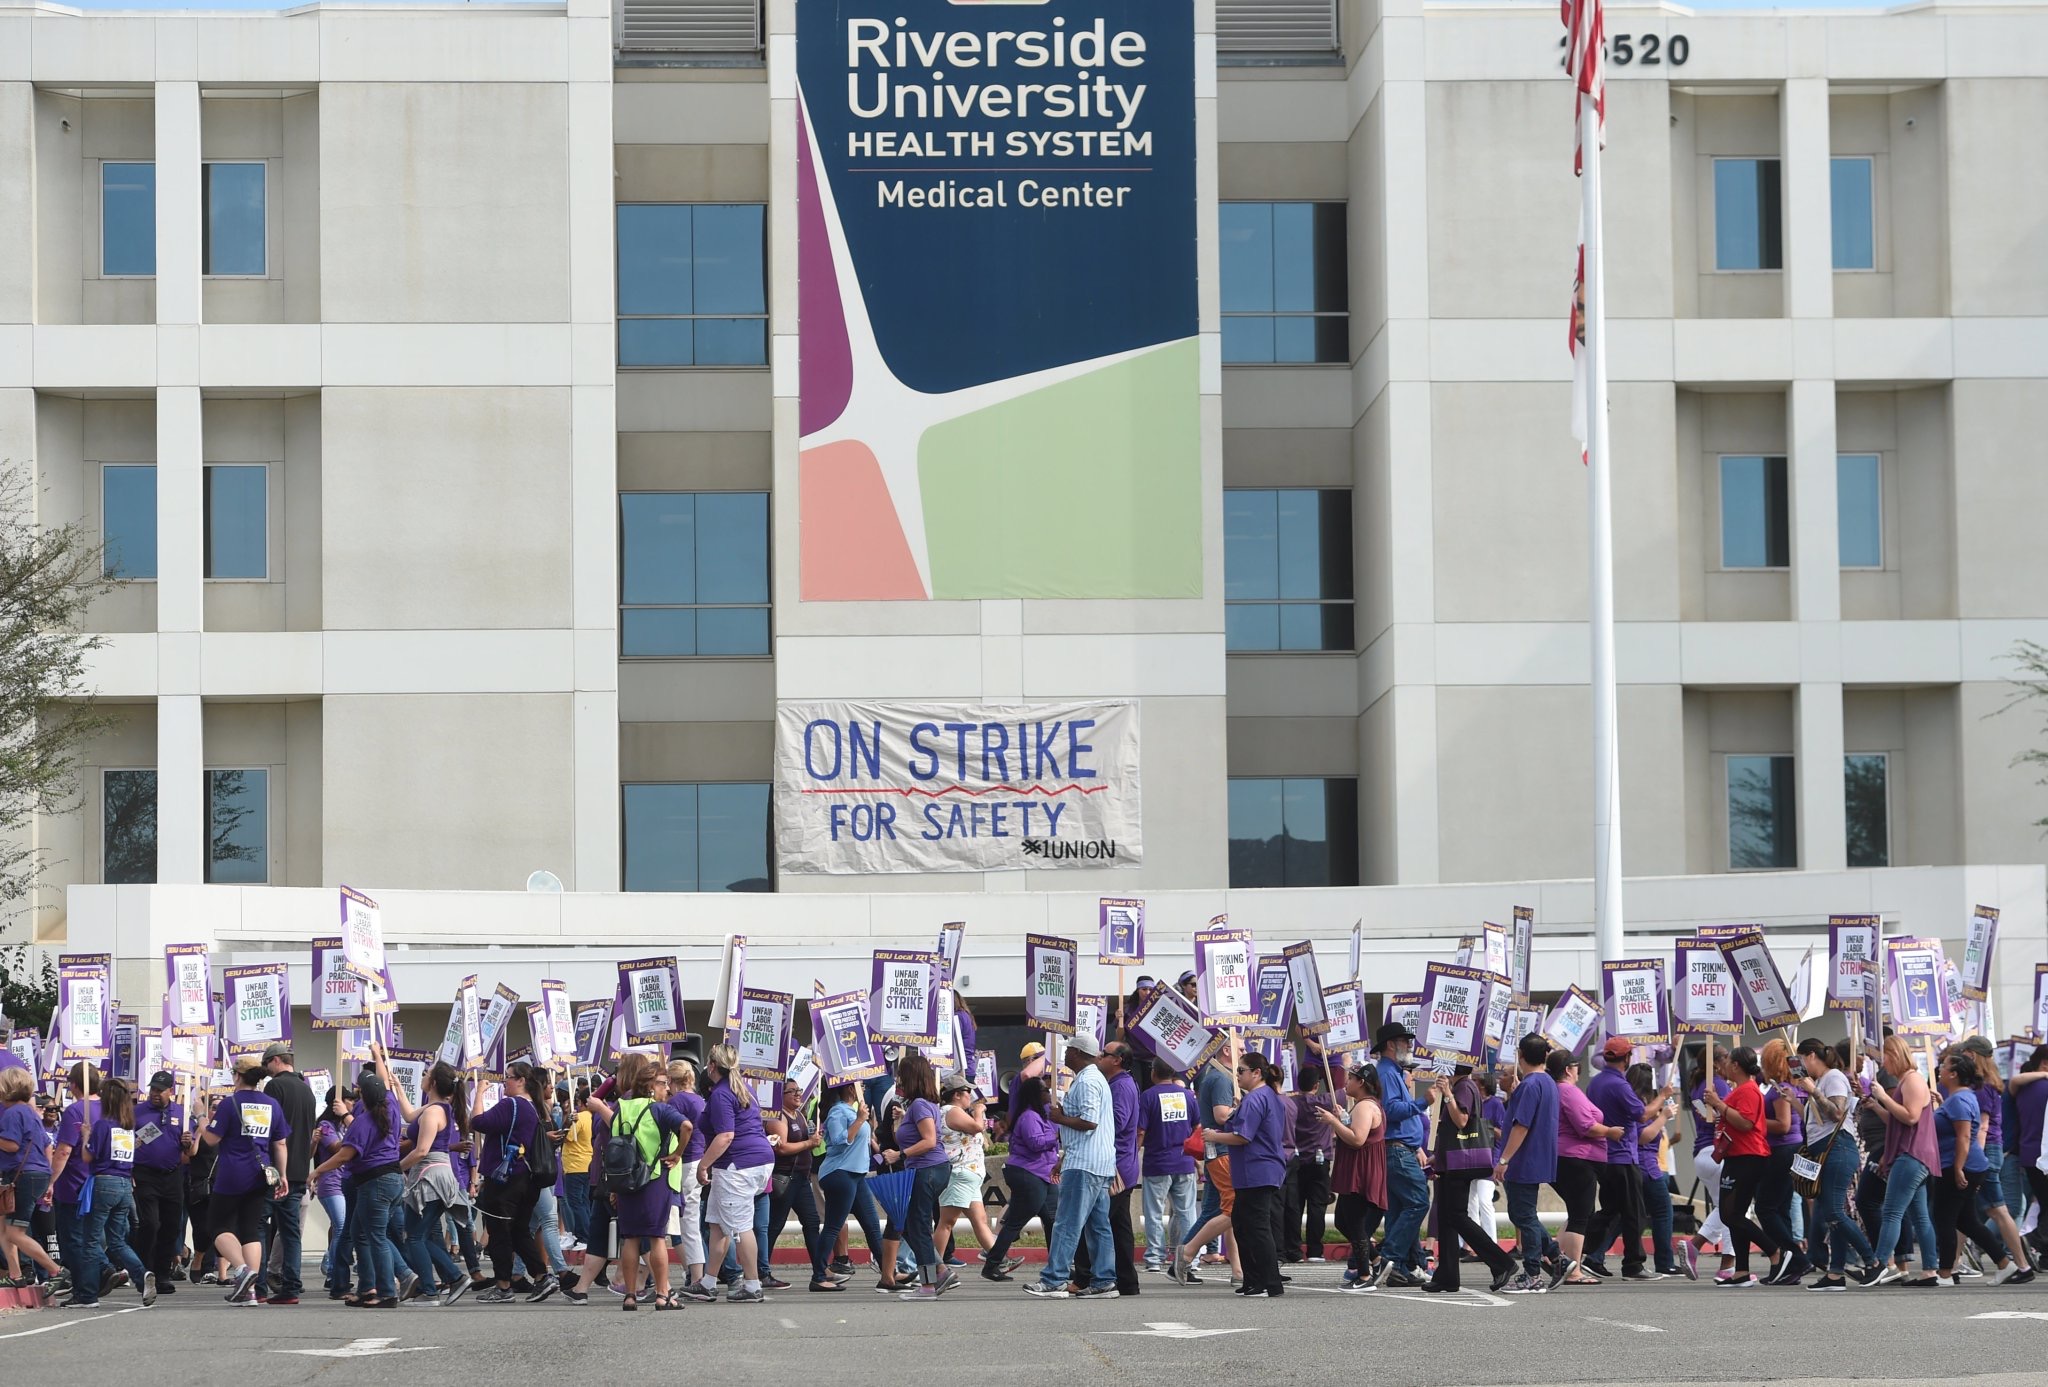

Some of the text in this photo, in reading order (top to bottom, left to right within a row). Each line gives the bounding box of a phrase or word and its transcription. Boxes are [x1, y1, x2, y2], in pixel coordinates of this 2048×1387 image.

[848, 16, 1147, 68] Riverside
[1560, 34, 1690, 66] 520
[848, 70, 1147, 129] University
[848, 131, 1153, 157] HEALTH SYSTEM
[877, 180, 1131, 208] Medical Center
[804, 719, 1097, 781] ON STRIKE
[831, 802, 1066, 841] FOR SAFETY
[1212, 933, 1229, 941] Local
[1042, 939, 1057, 947] Local
[1721, 938, 1748, 950] SEIU Local
[1847, 944, 1863, 952] LABOR
[1043, 956, 1061, 965] UNFAIR
[1216, 954, 1244, 965] STRIKING
[1044, 965, 1061, 974] LABOR
[1222, 965, 1234, 975] FOR
[1428, 965, 1480, 979] SEIU Local 721
[1692, 963, 1726, 972] STRIKING
[184, 972, 197, 980] LABOR
[895, 970, 919, 978] UNFAIR
[1040, 973, 1064, 983] PRACTICE
[1702, 973, 1717, 983] FOR
[182, 980, 201, 988] PRACTICE
[640, 975, 660, 984] UNFAIR
[896, 979, 917, 987] LABOR
[1217, 975, 1245, 989] SAFETY
[1623, 978, 1645, 987] UNFAIR
[78, 987, 93, 995] UNFAIR
[245, 982, 268, 991] UNFAIR
[326, 981, 356, 993] STRIKE
[642, 984, 660, 992] LABOR
[1038, 982, 1064, 998] STRIKE
[1330, 986, 1342, 994] Local
[1445, 984, 1468, 996] UNFAIR
[1625, 986, 1644, 994] LABOR
[1692, 984, 1726, 996] SAFETY
[182, 989, 204, 1002] STRIKE
[247, 991, 267, 999] LABOR
[639, 991, 664, 1000] PRACTICE
[890, 988, 921, 996] PRACTICE
[828, 998, 844, 1006] Local
[1444, 994, 1465, 1005] LABOR
[1621, 993, 1650, 1002] PRACTICE
[243, 999, 272, 1008] PRACTICE
[638, 1000, 667, 1013] STRIKE
[886, 996, 923, 1010] STRIKE
[1327, 1000, 1352, 1011] STRIKING
[1830, 1000, 1839, 1008] IN
[240, 1006, 275, 1020] STRIKE
[752, 1006, 772, 1016] UNFAIR
[1335, 1008, 1345, 1016] FOR
[1438, 1002, 1469, 1015] PRACTICE
[1619, 1002, 1653, 1015] STRIKE
[75, 1013, 99, 1025] STRIKE
[752, 1015, 771, 1024] LABOR
[1128, 1014, 1140, 1030] SEIU
[1139, 1000, 1151, 1015] Local
[1151, 1006, 1169, 1027] UNFAIR
[1204, 1014, 1258, 1026] IN ACTION!
[1432, 1010, 1469, 1029] STRIKE
[312, 1018, 370, 1028] IN ACTION!
[1028, 1019, 1075, 1034] IN ACTION!
[1157, 1012, 1174, 1031] LABOR
[1330, 1015, 1354, 1029] SAFETY
[1758, 1020, 1768, 1029] IN
[173, 1026, 182, 1035] IN
[747, 1023, 774, 1033] PRACTICE
[1161, 1015, 1183, 1040] PRACTICE
[1677, 1024, 1742, 1032] IN ACTION!
[1898, 1025, 1909, 1034] IN
[629, 1032, 685, 1045] IN ACTION!
[743, 1030, 774, 1046] STRIKE
[870, 1034, 935, 1045] IN ACTION!
[1166, 1019, 1193, 1050] STRIKE
[64, 1049, 72, 1057] IN
[230, 1045, 242, 1053] IN
[1333, 1041, 1368, 1055] ACTION!
[1415, 1047, 1428, 1057] IN
[1186, 1032, 1224, 1080] IN ACTION!
[393, 1067, 413, 1075] UNFAIR
[742, 1069, 785, 1080] ACTION!
[829, 1066, 885, 1086] IN ACTION!
[1163, 1110, 1187, 1120] SEIU
[243, 1125, 268, 1135] SEIU
[113, 1150, 132, 1159] SEIU
